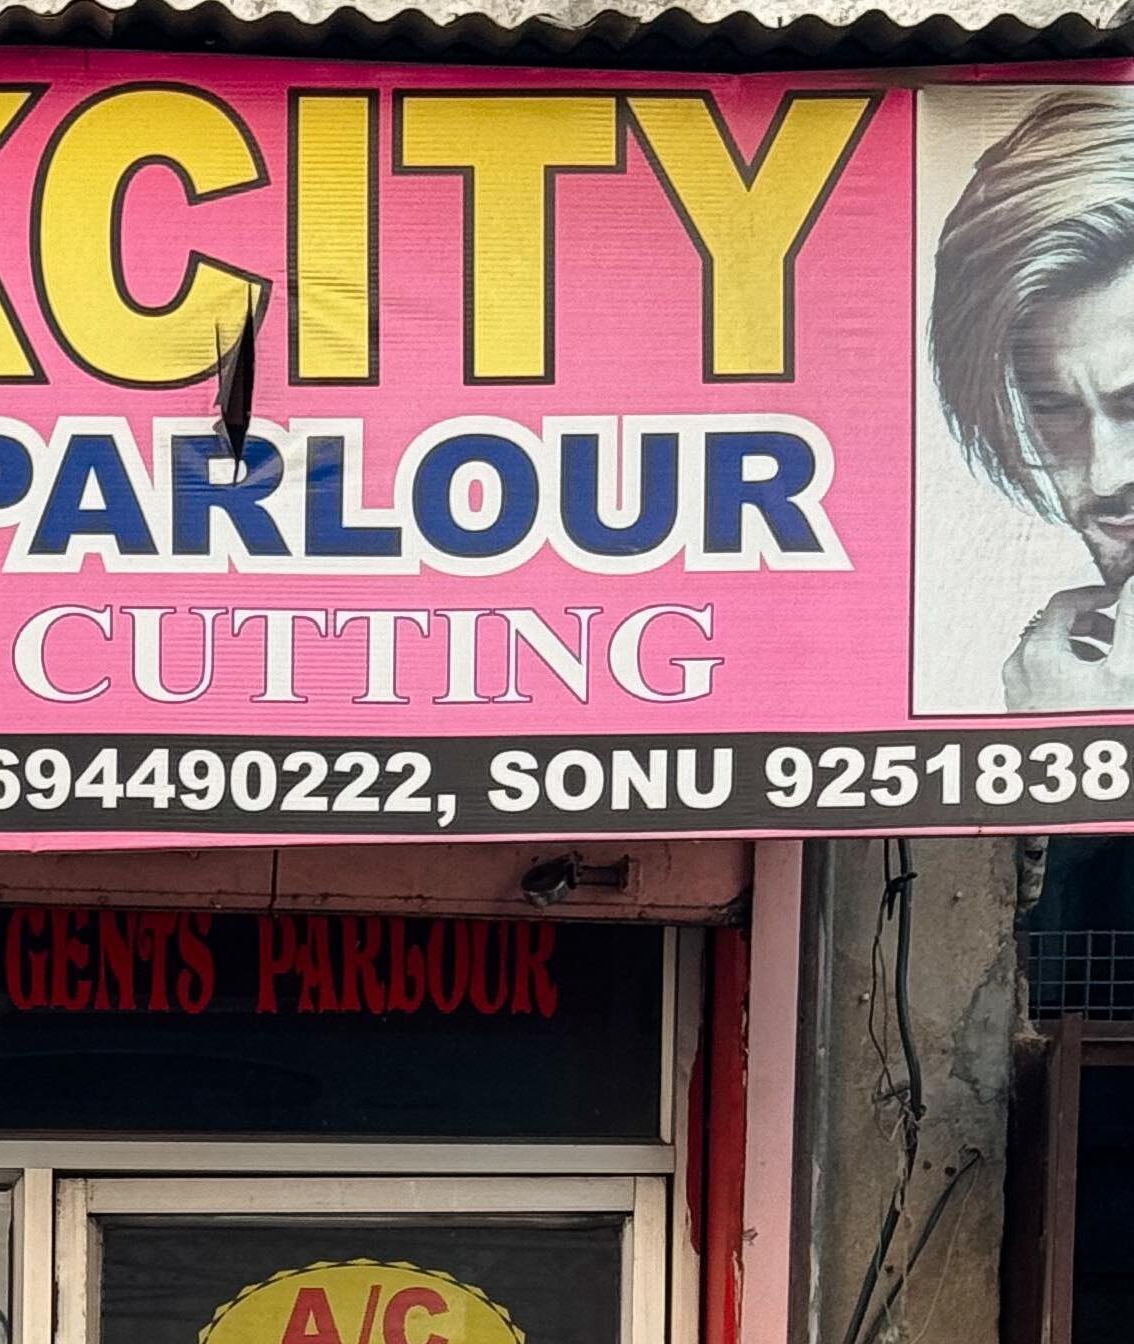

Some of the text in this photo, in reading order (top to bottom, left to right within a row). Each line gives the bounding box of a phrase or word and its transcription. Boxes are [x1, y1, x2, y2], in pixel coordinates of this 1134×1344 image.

[11, 603, 725, 706] CUTTING
[487, 748, 733, 812] SONU
[765, 739, 1130, 808] 9251838
[6, 906, 216, 1014] GENTS
[256, 914, 558, 1018] PARLOUR
